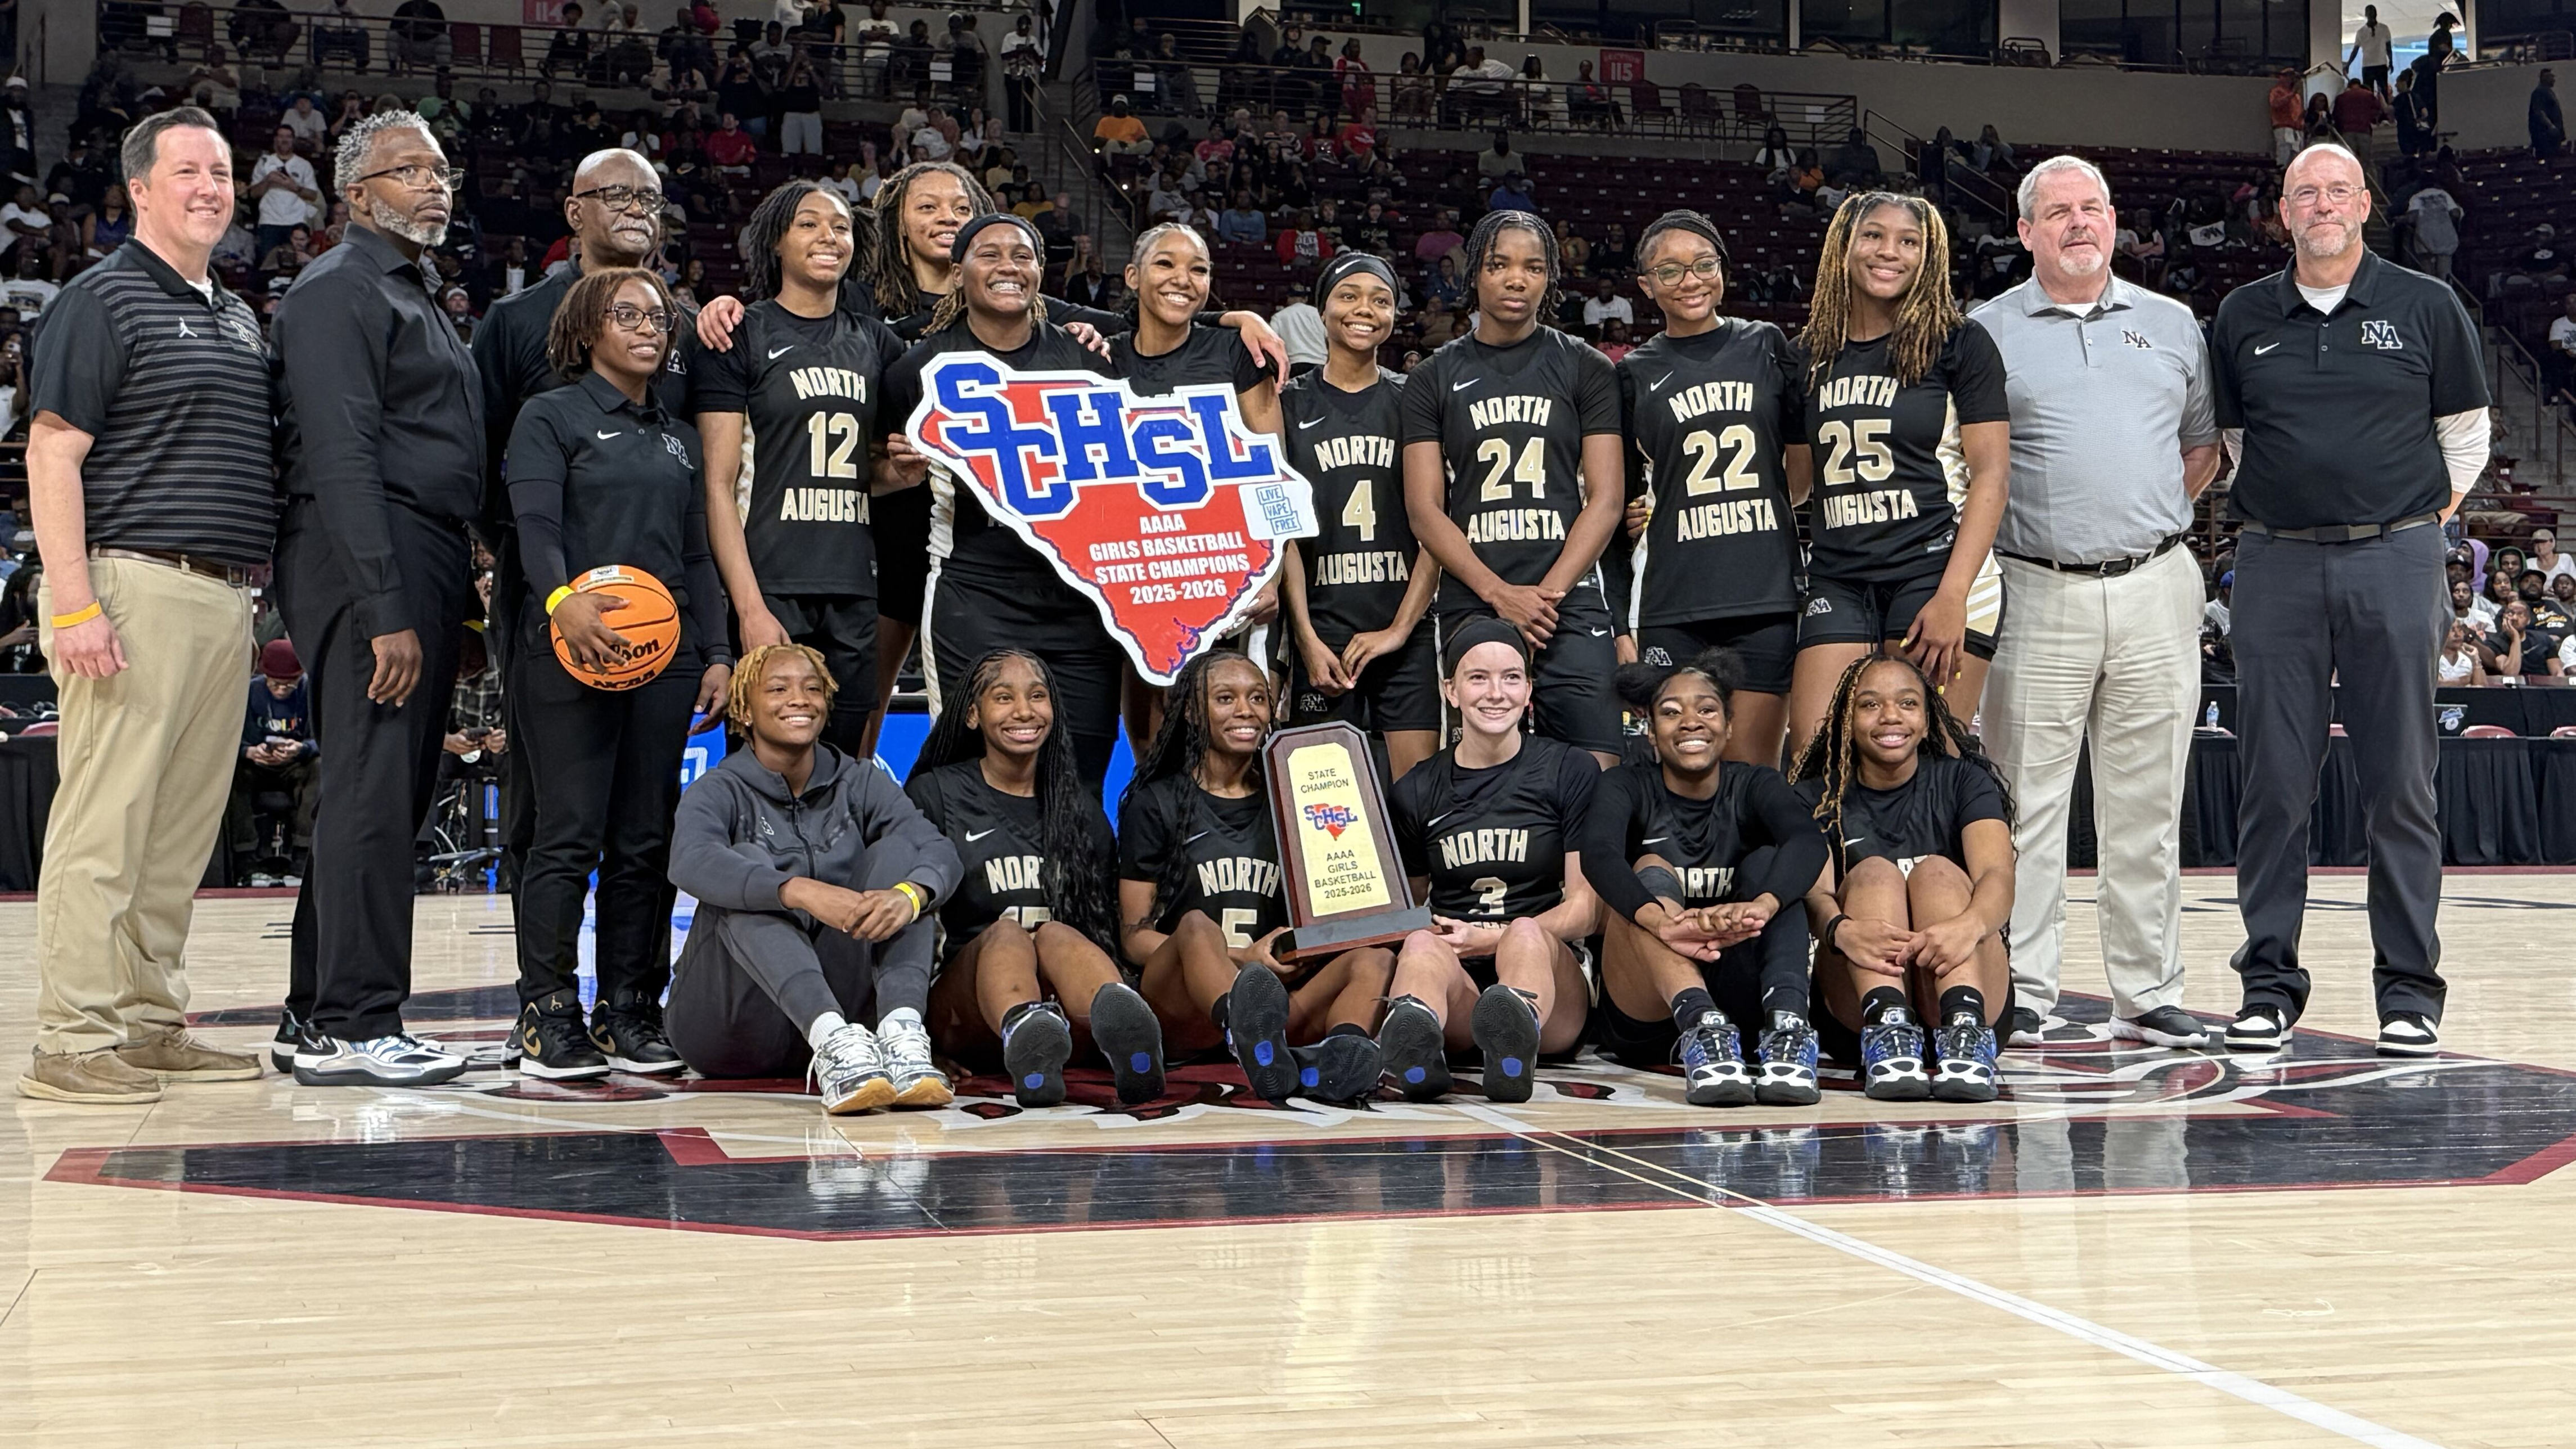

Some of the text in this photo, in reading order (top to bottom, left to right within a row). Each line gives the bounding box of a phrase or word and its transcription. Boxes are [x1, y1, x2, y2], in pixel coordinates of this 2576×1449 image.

[1611, 62, 1633, 82] 115
[2121, 330, 2153, 349] NA
[2362, 321, 2403, 349] NA
[789, 367, 866, 404] NORTH
[1668, 381, 1753, 423] NORTH
[1819, 375, 1899, 412] NORTH
[1469, 395, 1552, 430] NORTH
[808, 411, 858, 479] 12
[933, 362, 1277, 516] SCHSL
[1314, 435, 1395, 472] NORTH
[1818, 418, 1894, 486] 25
[1477, 436, 1545, 502] 24
[1683, 424, 1759, 497] 22
[780, 488, 870, 525] AUGUSTA
[1260, 488, 1282, 501] LIVE
[1266, 503, 1288, 516] VAPE
[1342, 480, 1376, 541] 4
[1140, 514, 1187, 534] AAAA
[1275, 517, 1297, 531] FREE
[1467, 509, 1565, 543] AUGUSTA
[1677, 498, 1778, 542] AUGUSTA
[1089, 531, 1246, 561] GIRLS BASKETBALL
[1094, 554, 1250, 584] STATE CHAMPIONS
[1315, 551, 1408, 586] AUGUSTA
[1130, 578, 1227, 605] 2025-2026
[1301, 778, 1349, 793] CHAMPION
[1308, 768, 1336, 780] STATE
[1303, 804, 1359, 830] SCHSL
[1327, 850, 1355, 861] AAAA
[1439, 828, 1528, 870] NORTH
[985, 855, 1044, 894] NOR
[1197, 857, 1280, 898] NORTH
[1315, 871, 1376, 888] BASKETBALL
[1328, 861, 1358, 874] GIRLS
[1674, 867, 1734, 898] RTH
[1324, 883, 1372, 899] 2025-2026
[1221, 908, 1257, 949] 5
